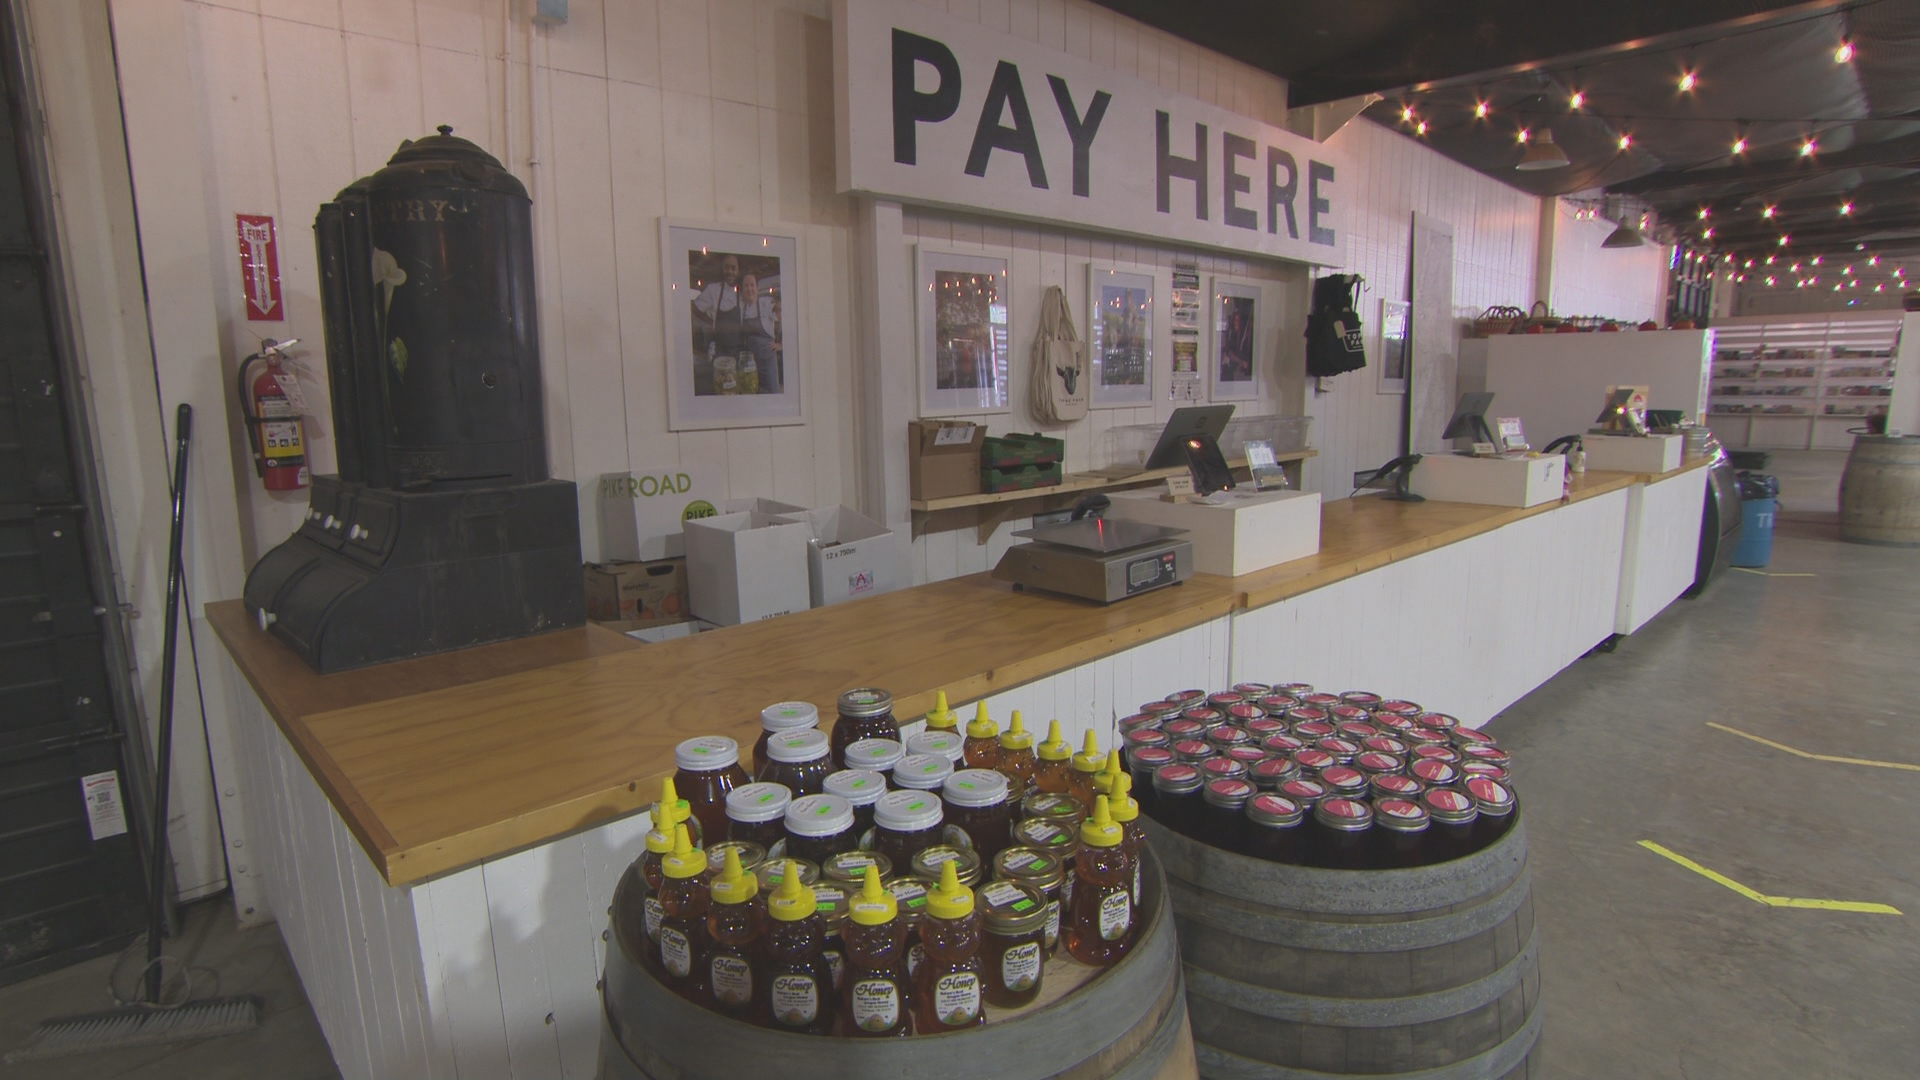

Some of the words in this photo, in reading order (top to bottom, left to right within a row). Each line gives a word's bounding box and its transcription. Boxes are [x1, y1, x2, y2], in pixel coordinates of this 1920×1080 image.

[891, 27, 1112, 198] PAY
[1155, 109, 1335, 246] HERE
[247, 229, 268, 241] FIRE
[603, 479, 624, 499] PIKE
[627, 473, 692, 498] ROAD
[826, 552, 834, 560] 12
[1103, 895, 1128, 909] Honey
[662, 929, 687, 950] Honey
[1005, 946, 1038, 960] Honey
[713, 959, 747, 977] Honey
[775, 978, 813, 994] Honey
[855, 983, 893, 998] Honey
[939, 976, 976, 990] Honey
